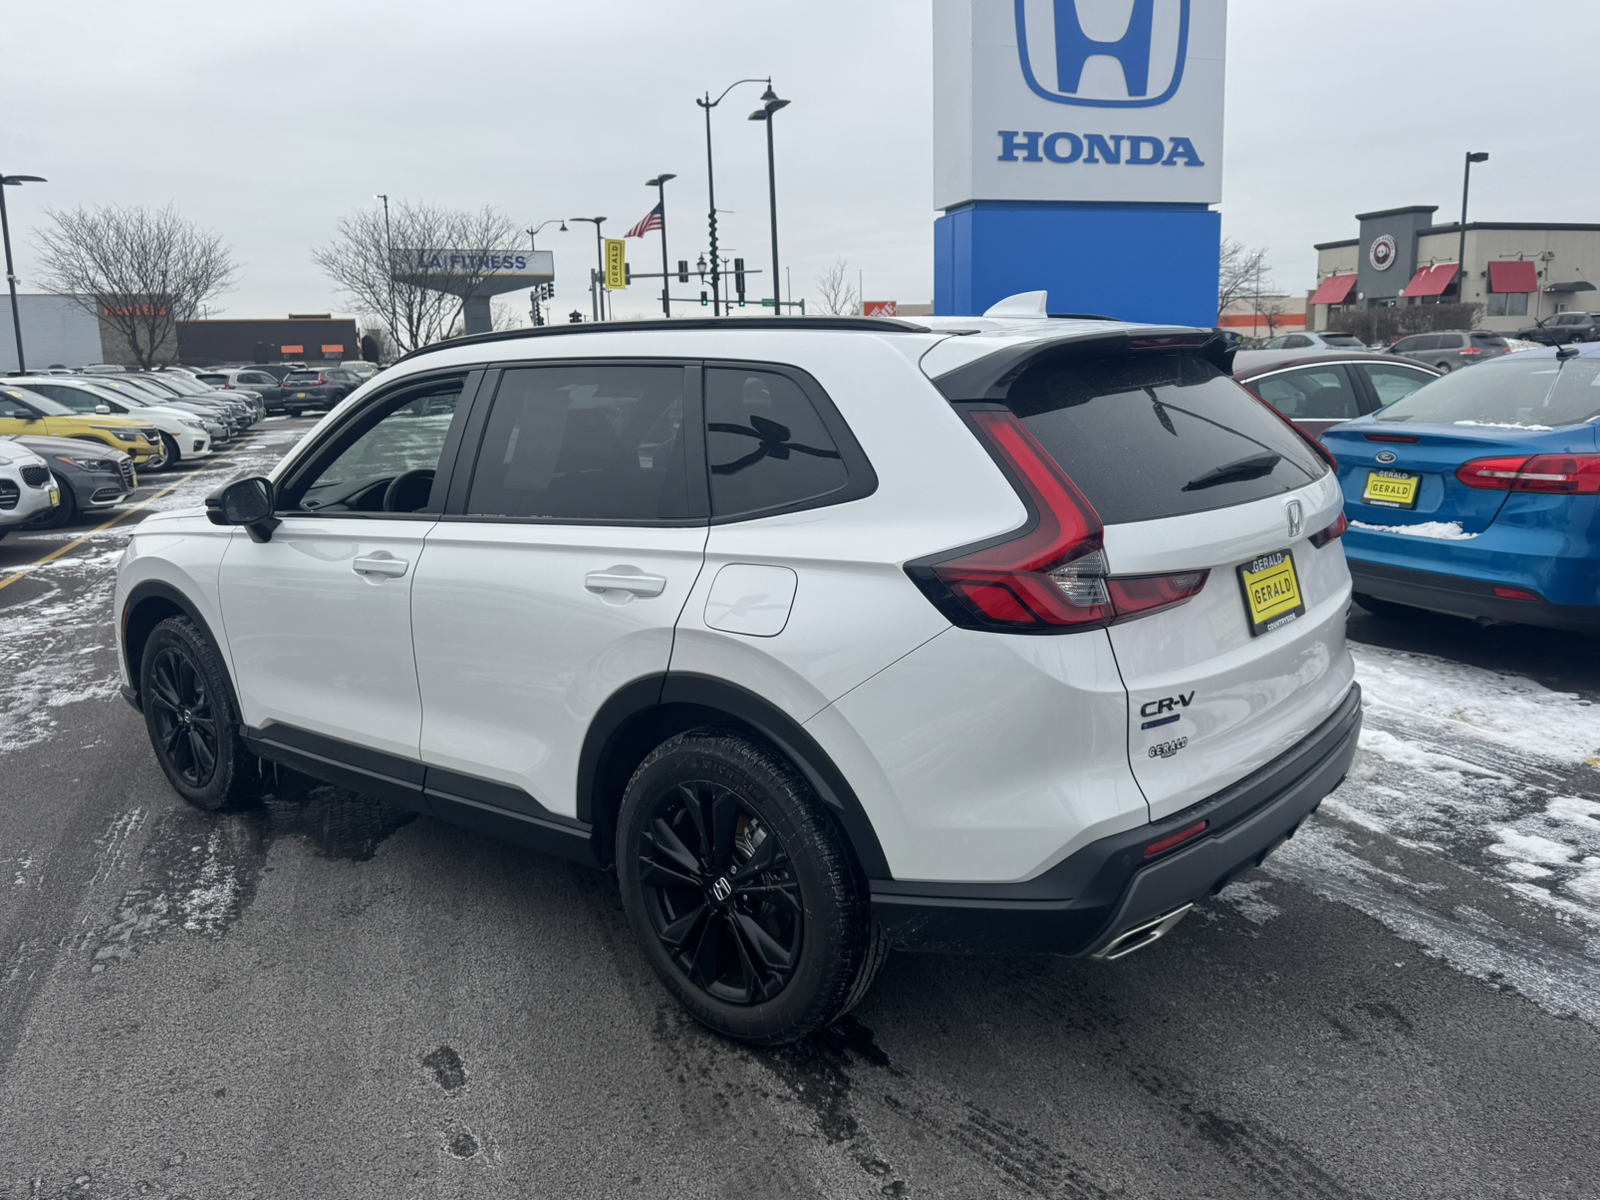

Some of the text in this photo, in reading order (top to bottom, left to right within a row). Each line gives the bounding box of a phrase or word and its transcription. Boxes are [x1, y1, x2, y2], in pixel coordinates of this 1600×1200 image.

[997, 130, 1205, 167] HONDA
[451, 255, 527, 270] FITNESS
[611, 245, 619, 283] GERALD
[1378, 470, 1409, 479] GERALD
[1372, 483, 1409, 495] GERALD
[1252, 552, 1283, 573] GERALD
[1254, 577, 1291, 605] GERALD
[1267, 612, 1297, 631] COUNTRYSIDE
[1140, 690, 1196, 718] CR-V
[1148, 736, 1188, 759] GERALD
